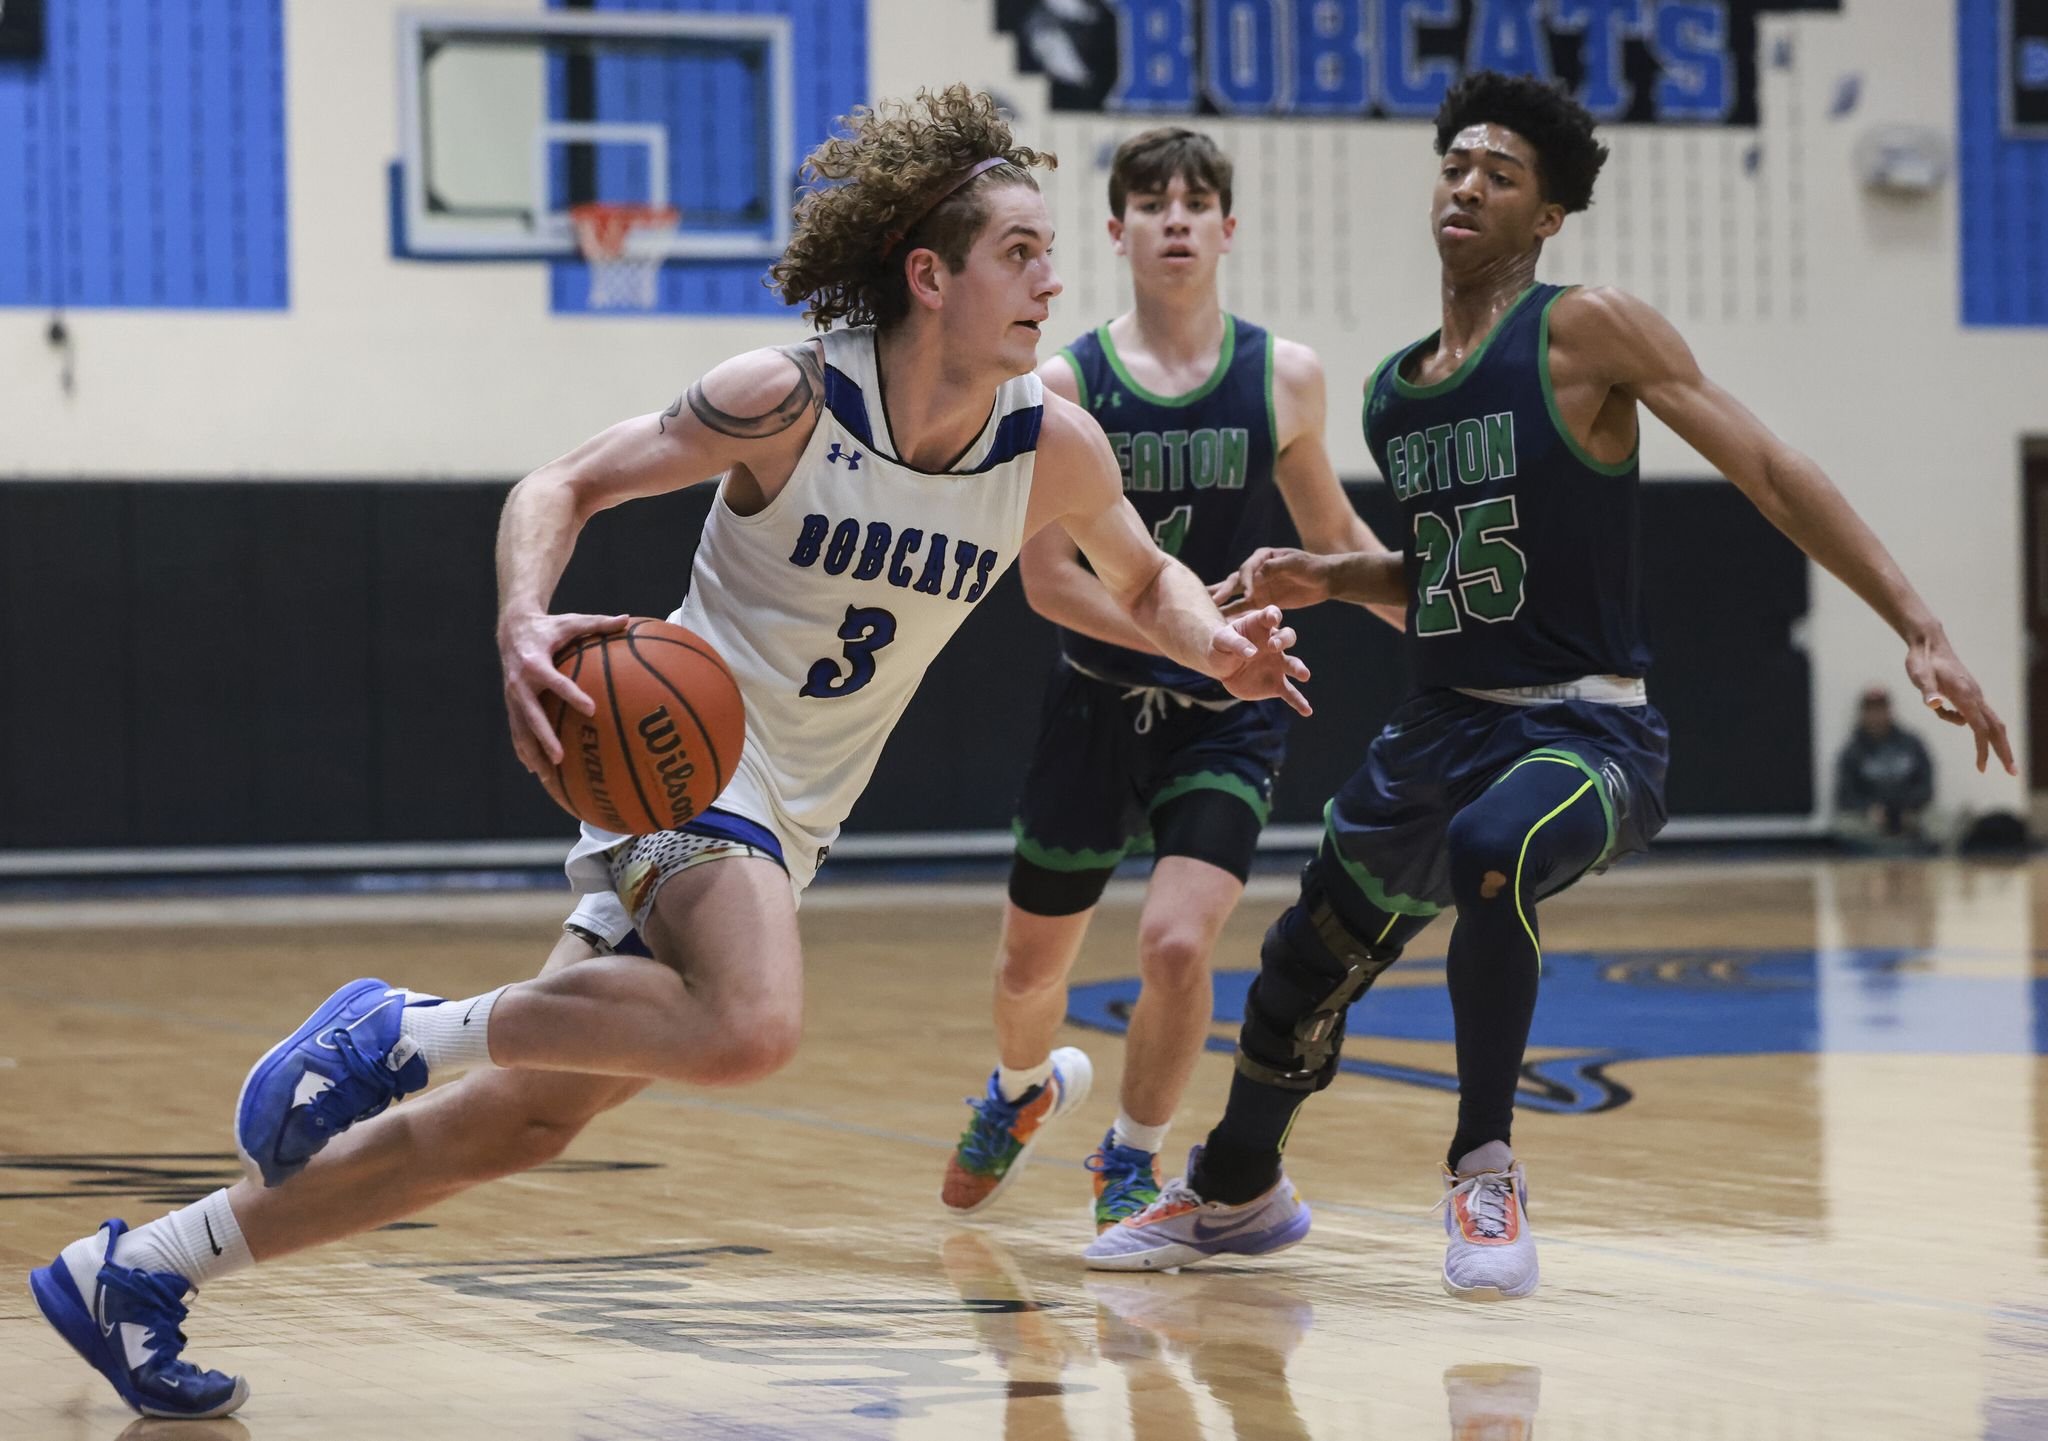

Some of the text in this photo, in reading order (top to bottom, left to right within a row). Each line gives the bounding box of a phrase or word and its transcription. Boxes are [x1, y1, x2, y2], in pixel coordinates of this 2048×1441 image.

[1104, 0, 1734, 118] BOBCATS
[1106, 427, 1249, 492] EATON
[1387, 412, 1516, 501] EATON
[789, 513, 998, 603] BOBCATS
[1414, 495, 1527, 637] 25
[799, 603, 897, 699] 3
[638, 705, 695, 824] Wilson
